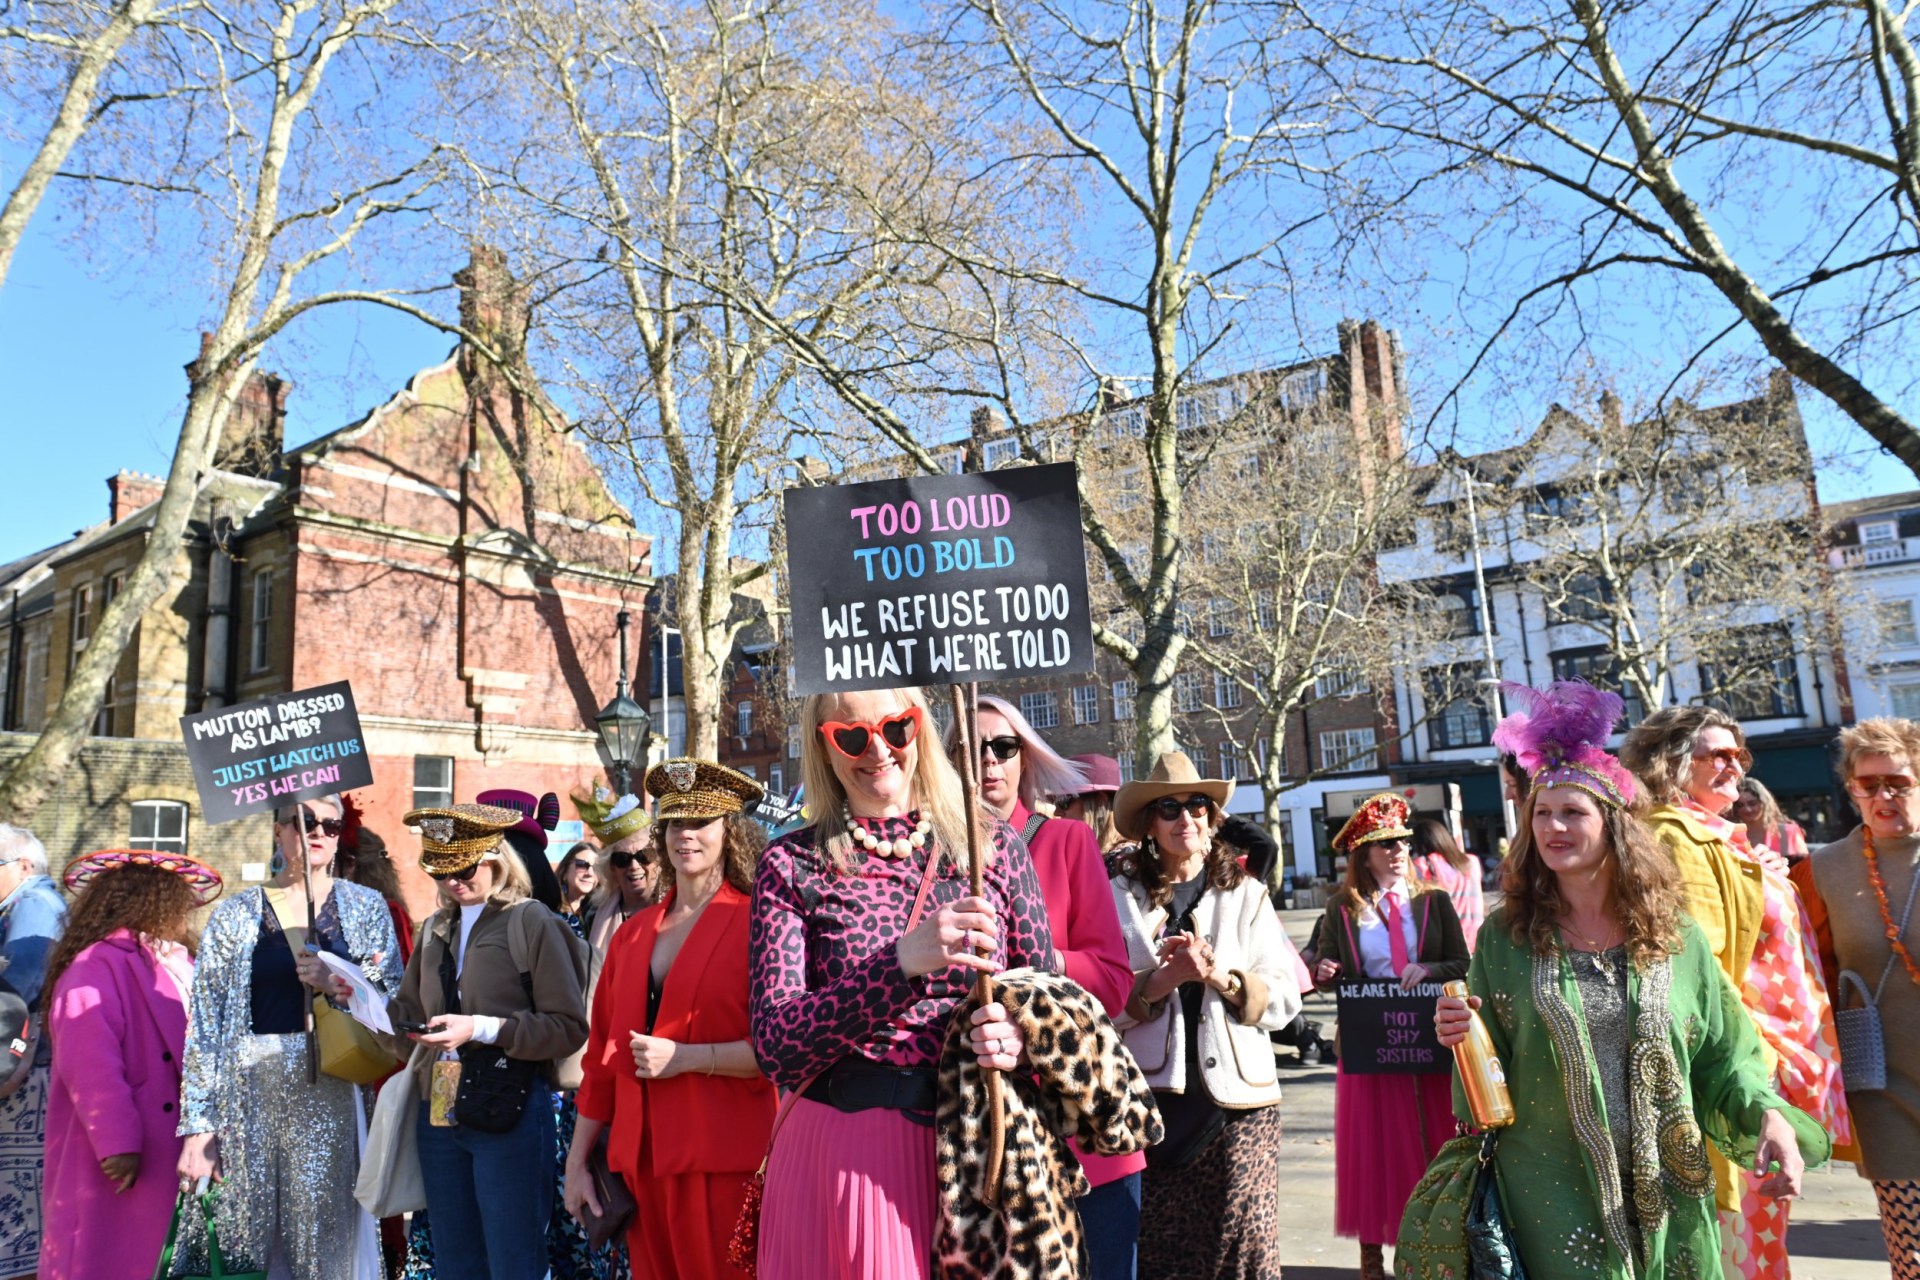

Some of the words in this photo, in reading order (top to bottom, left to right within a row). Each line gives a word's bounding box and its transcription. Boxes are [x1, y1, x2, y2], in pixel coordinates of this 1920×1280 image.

[850, 500, 922, 540] TOO
[930, 493, 1011, 532] LOUD
[853, 543, 926, 582] TOO
[930, 535, 1016, 574] BOLD
[821, 601, 870, 640] WE
[878, 588, 990, 635] REFUSE
[995, 586, 1031, 624] TO
[1034, 583, 1070, 621] DO
[825, 638, 918, 682] WHAT
[928, 632, 1007, 674] WE'RE
[1007, 627, 1071, 668] TOLD
[192, 706, 272, 740] MUTTON
[277, 693, 345, 722] DRESSED
[230, 730, 258, 753] AS
[258, 717, 322, 746] LAMB?
[212, 758, 267, 787] JUST
[269, 742, 335, 773] WATCH
[337, 738, 361, 757] US
[231, 782, 268, 806] YES
[270, 774, 301, 797] WE
[301, 764, 341, 788] CAN
[769, 794, 787, 808] YOU
[1340, 984, 1360, 998] WE
[1361, 983, 1387, 998] ARE
[1383, 1011, 1419, 1026] NOT
[1386, 1029, 1420, 1045] SHY
[1376, 1048, 1434, 1064] SISTERS
